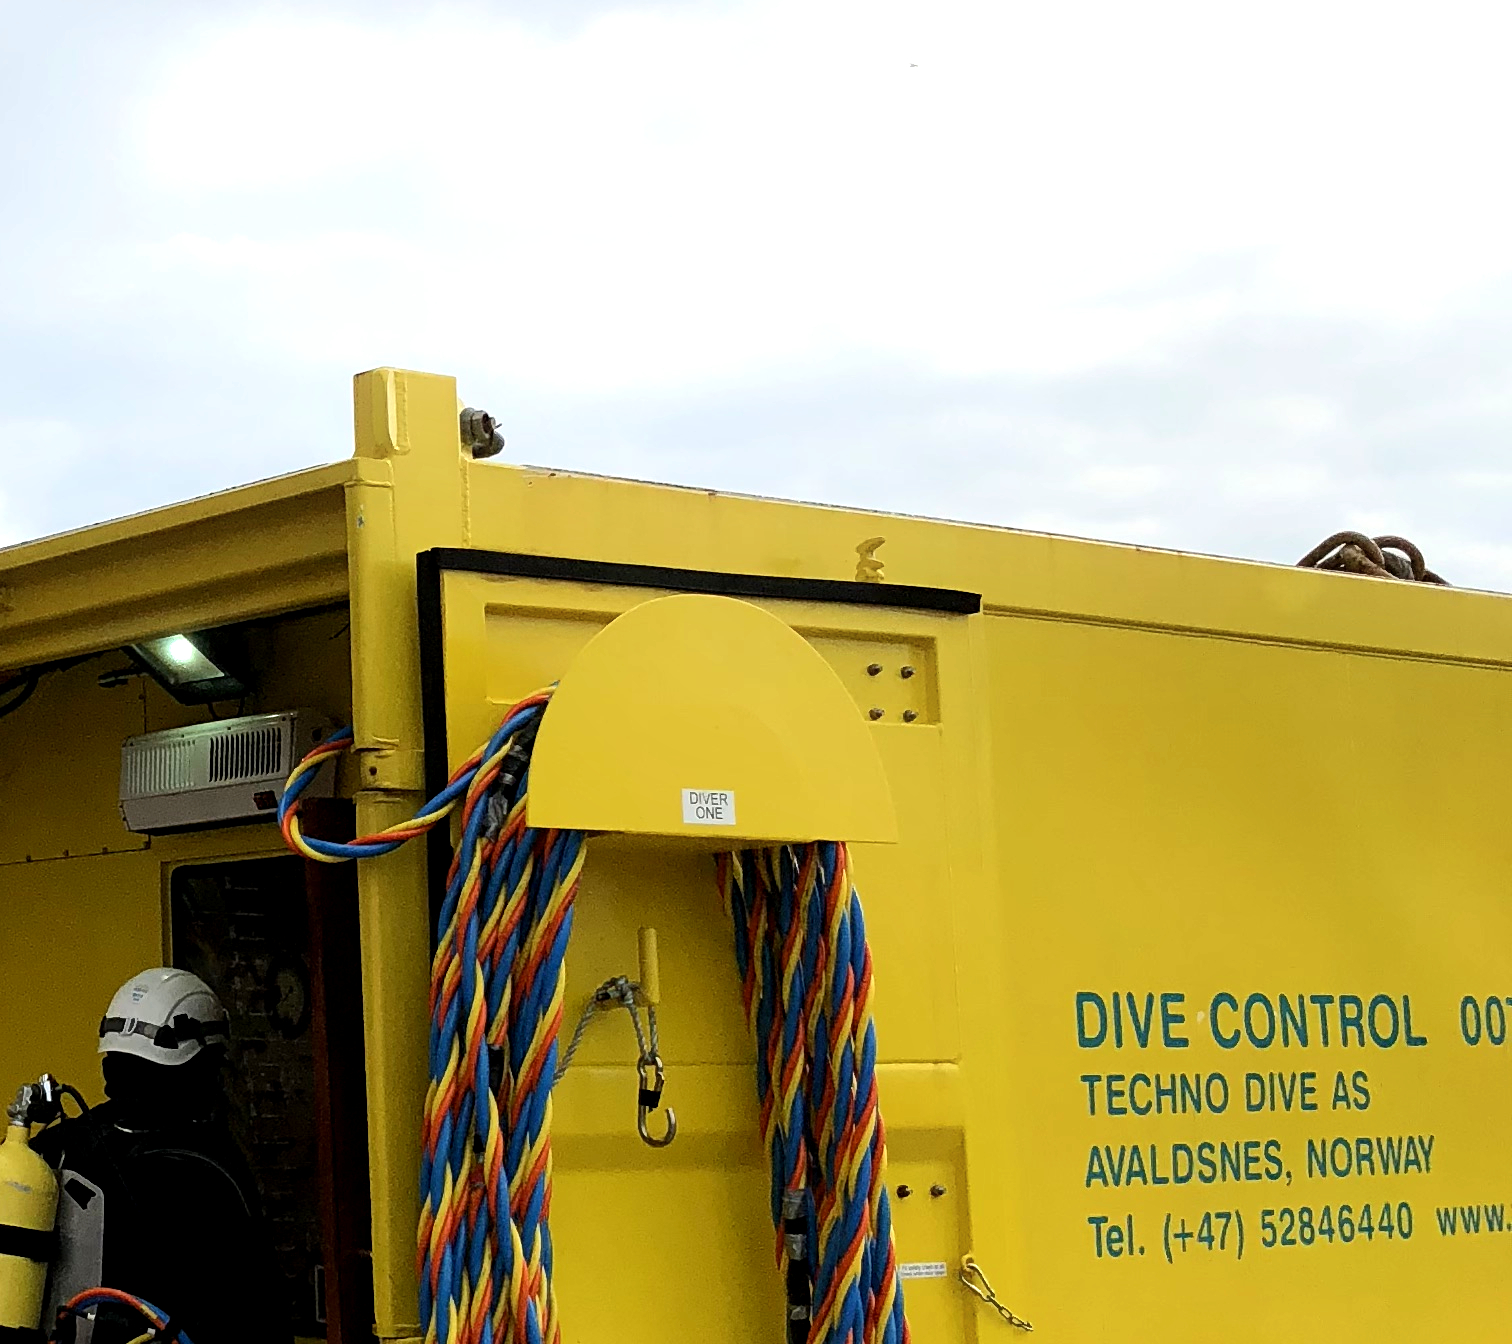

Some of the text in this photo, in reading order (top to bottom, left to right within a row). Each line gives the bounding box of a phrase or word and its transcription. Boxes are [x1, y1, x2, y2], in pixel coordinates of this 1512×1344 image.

[689, 791, 729, 806] DIVER
[695, 806, 724, 820] ONE
[1075, 991, 1190, 1049] DIVE
[1209, 992, 1428, 1050] CONTROL
[1080, 1070, 1371, 1116] TECHNO DIVE AS
[1085, 1134, 1435, 1188] AVALDSNES, NORWAY
[1087, 1213, 1145, 1258] Tel.
[1163, 1209, 1244, 1264] (+47)
[1261, 1201, 1413, 1248] 52846440
